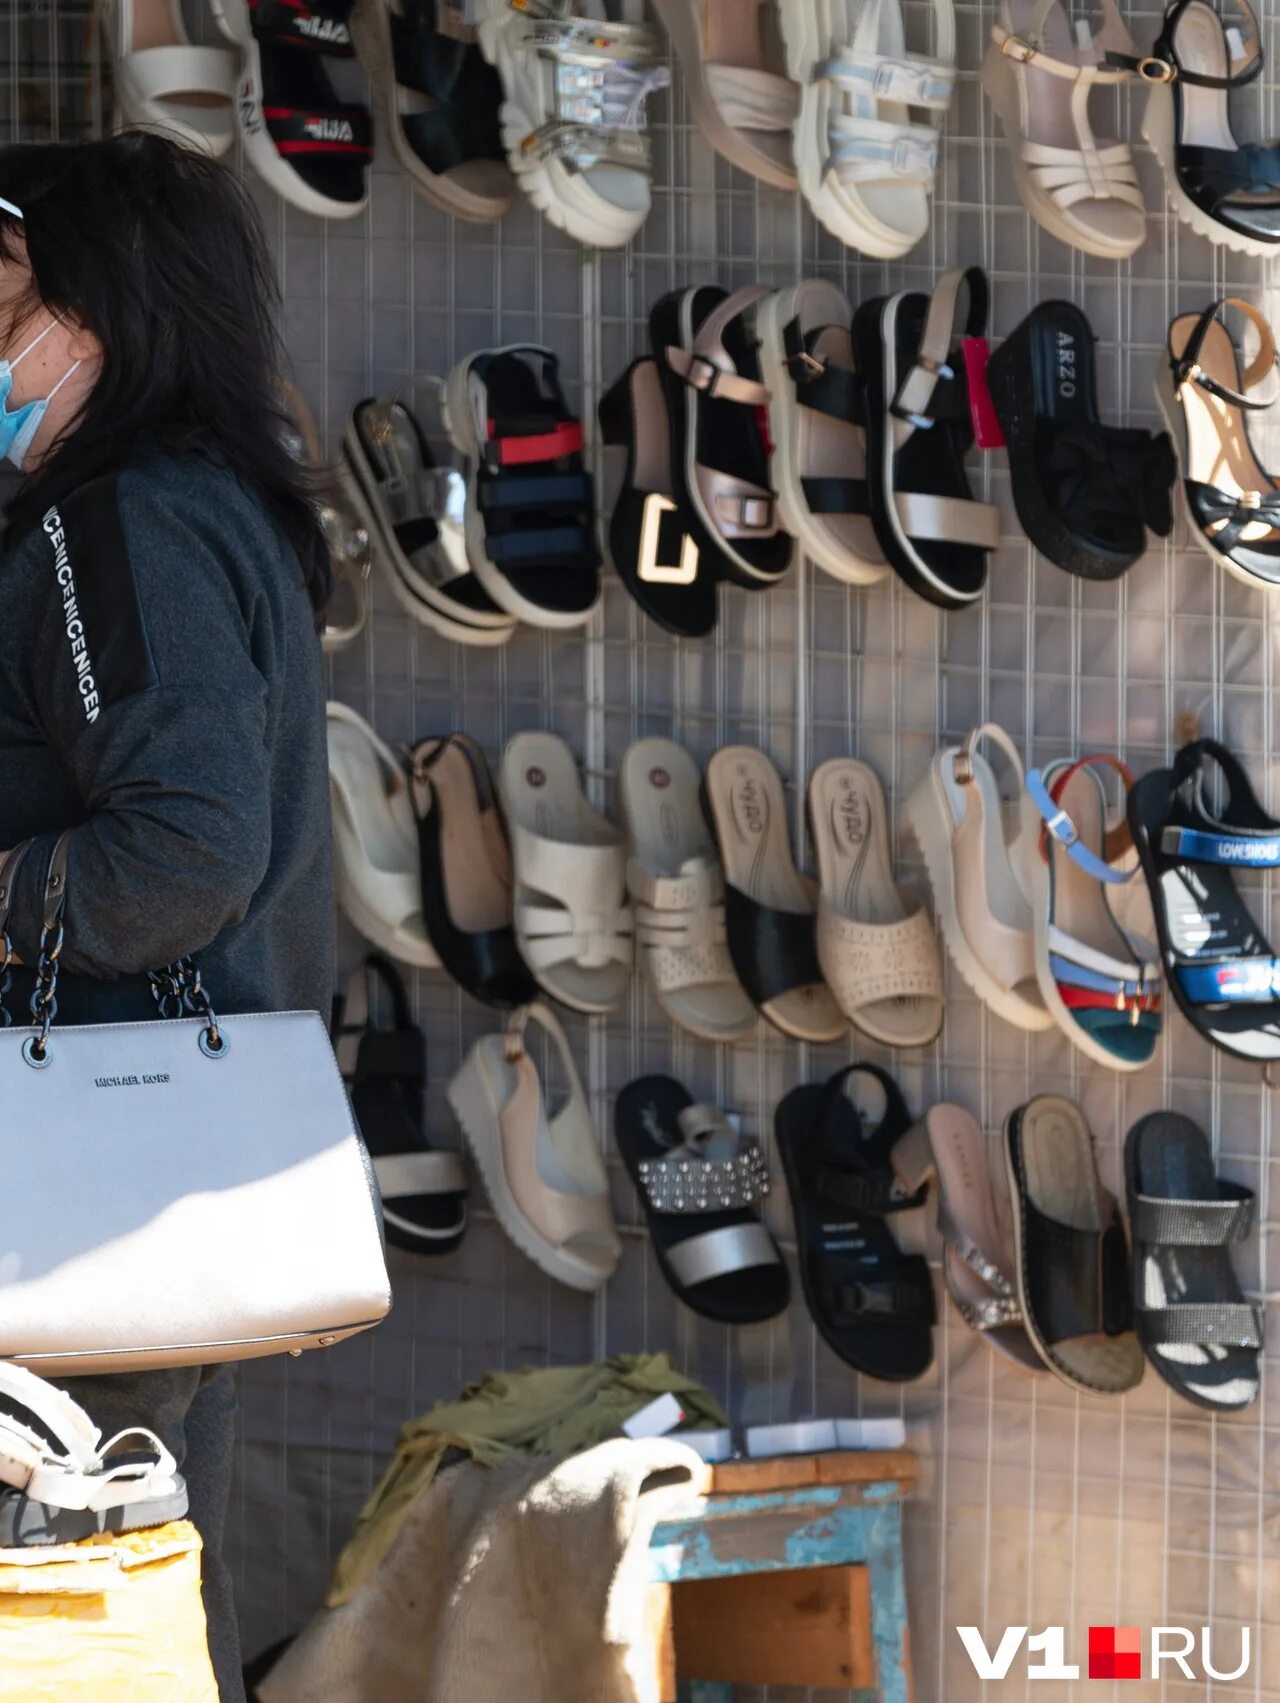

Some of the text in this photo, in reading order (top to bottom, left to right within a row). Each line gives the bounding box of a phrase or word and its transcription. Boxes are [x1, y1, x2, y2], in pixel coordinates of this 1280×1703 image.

[1057, 331, 1076, 398] ARZO
[94, 1073, 170, 1087] MICHAEL KORS
